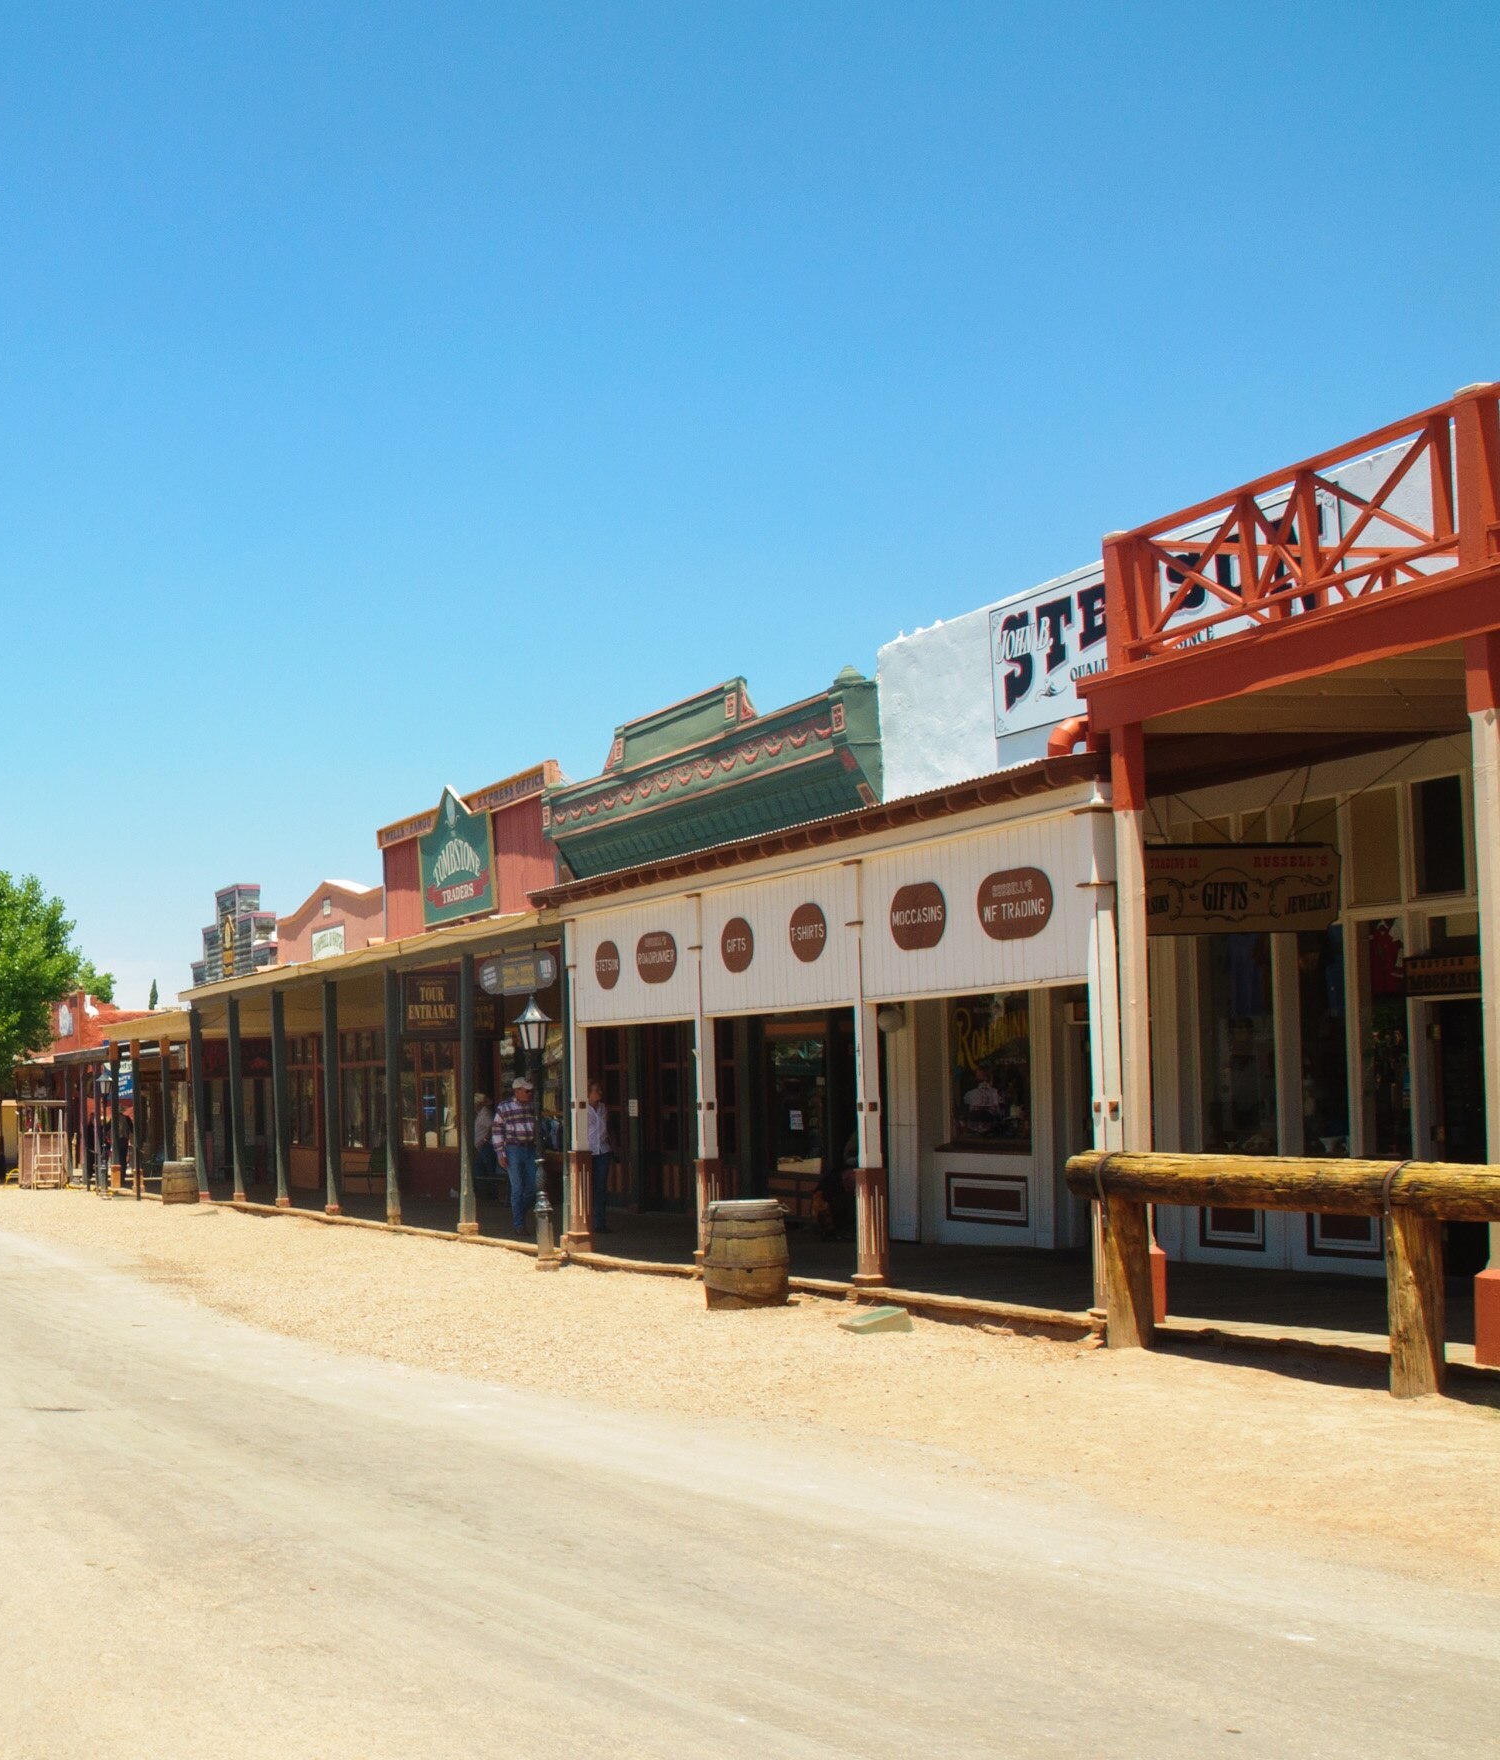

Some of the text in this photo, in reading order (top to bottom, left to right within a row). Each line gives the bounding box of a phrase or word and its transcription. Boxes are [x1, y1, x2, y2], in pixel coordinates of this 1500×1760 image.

[995, 623, 1035, 664] JOHN
[1069, 657, 1108, 682] QUALI
[477, 773, 545, 807] EXPRESS OFFICE
[385, 816, 432, 842] WELLS FARGO
[433, 838, 481, 888] TOMBSTONE
[1253, 855, 1329, 868] RUSSELL'S
[442, 883, 474, 905] TRADERS
[1202, 882, 1249, 911] GIFTS
[1285, 891, 1332, 915] JEWELRY
[891, 905, 943, 927] MOCCASINS
[1001, 898, 1046, 920] TRADING
[791, 923, 825, 941] T-SHIRTS
[726, 937, 747, 953] GIFTS
[595, 958, 619, 972] STETSON
[637, 950, 675, 965] ROADRUNNER
[419, 986, 445, 1002] TOUR
[408, 1003, 456, 1019] ENTRANCE
